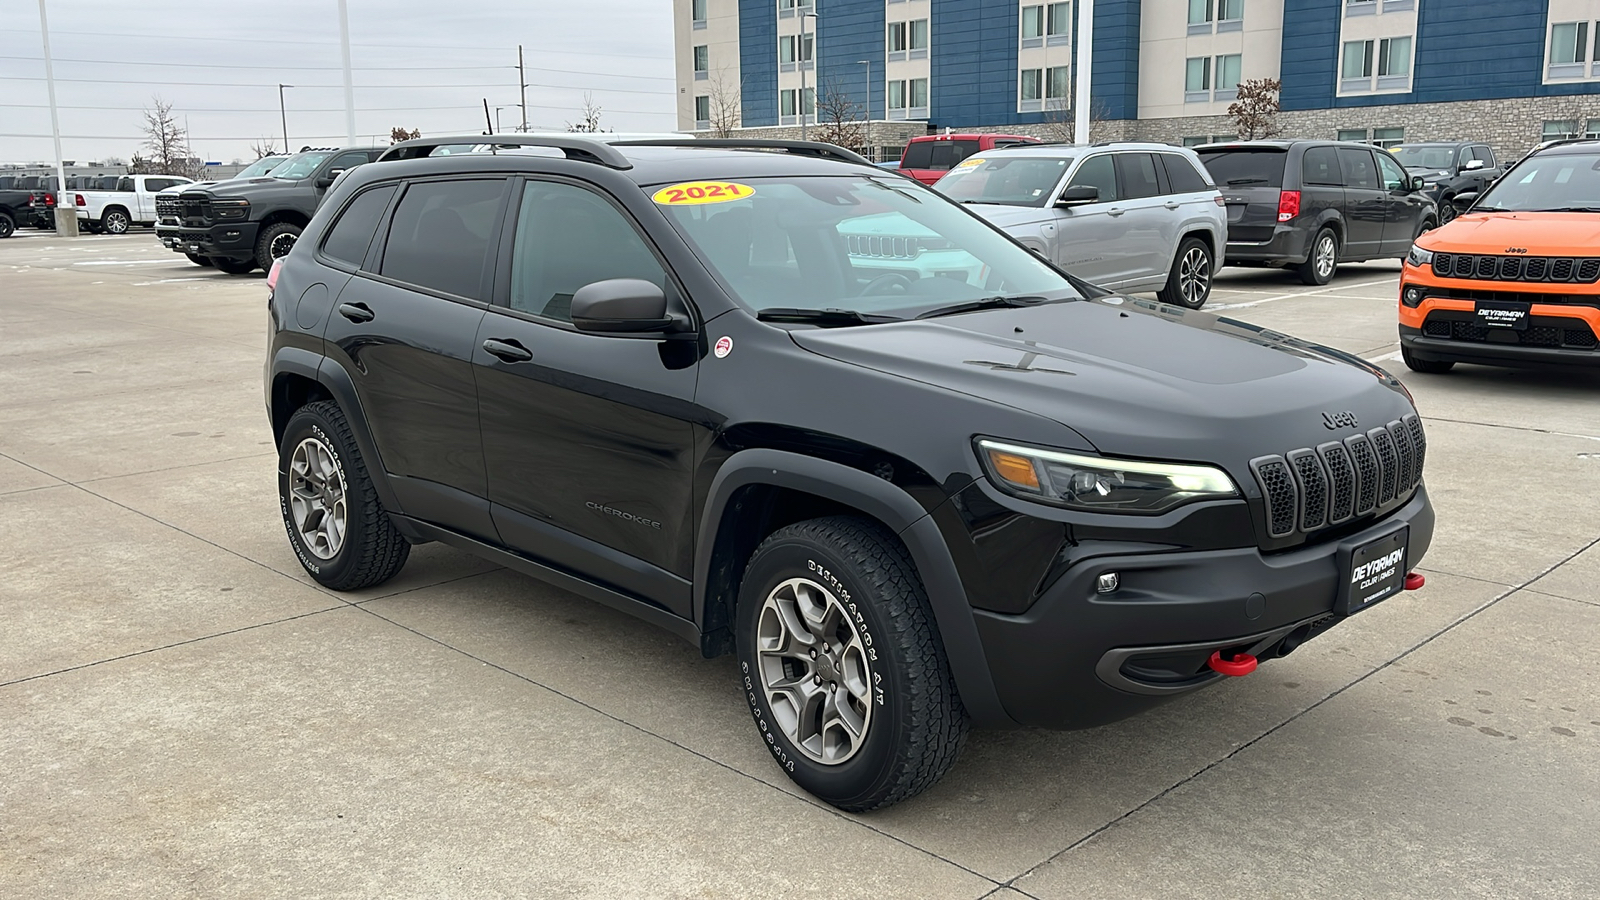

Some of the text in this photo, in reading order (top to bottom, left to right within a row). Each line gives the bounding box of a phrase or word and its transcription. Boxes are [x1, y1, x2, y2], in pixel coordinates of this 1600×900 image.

[666, 184, 740, 203] 2021
[1504, 246, 1528, 254] Jeep
[1477, 309, 1526, 318] DEYARMAN
[1321, 410, 1359, 431] Jeep
[585, 501, 662, 530] CHEROKEE
[1351, 546, 1405, 584] DEYARMAN
[807, 559, 878, 662] DESTINATION
